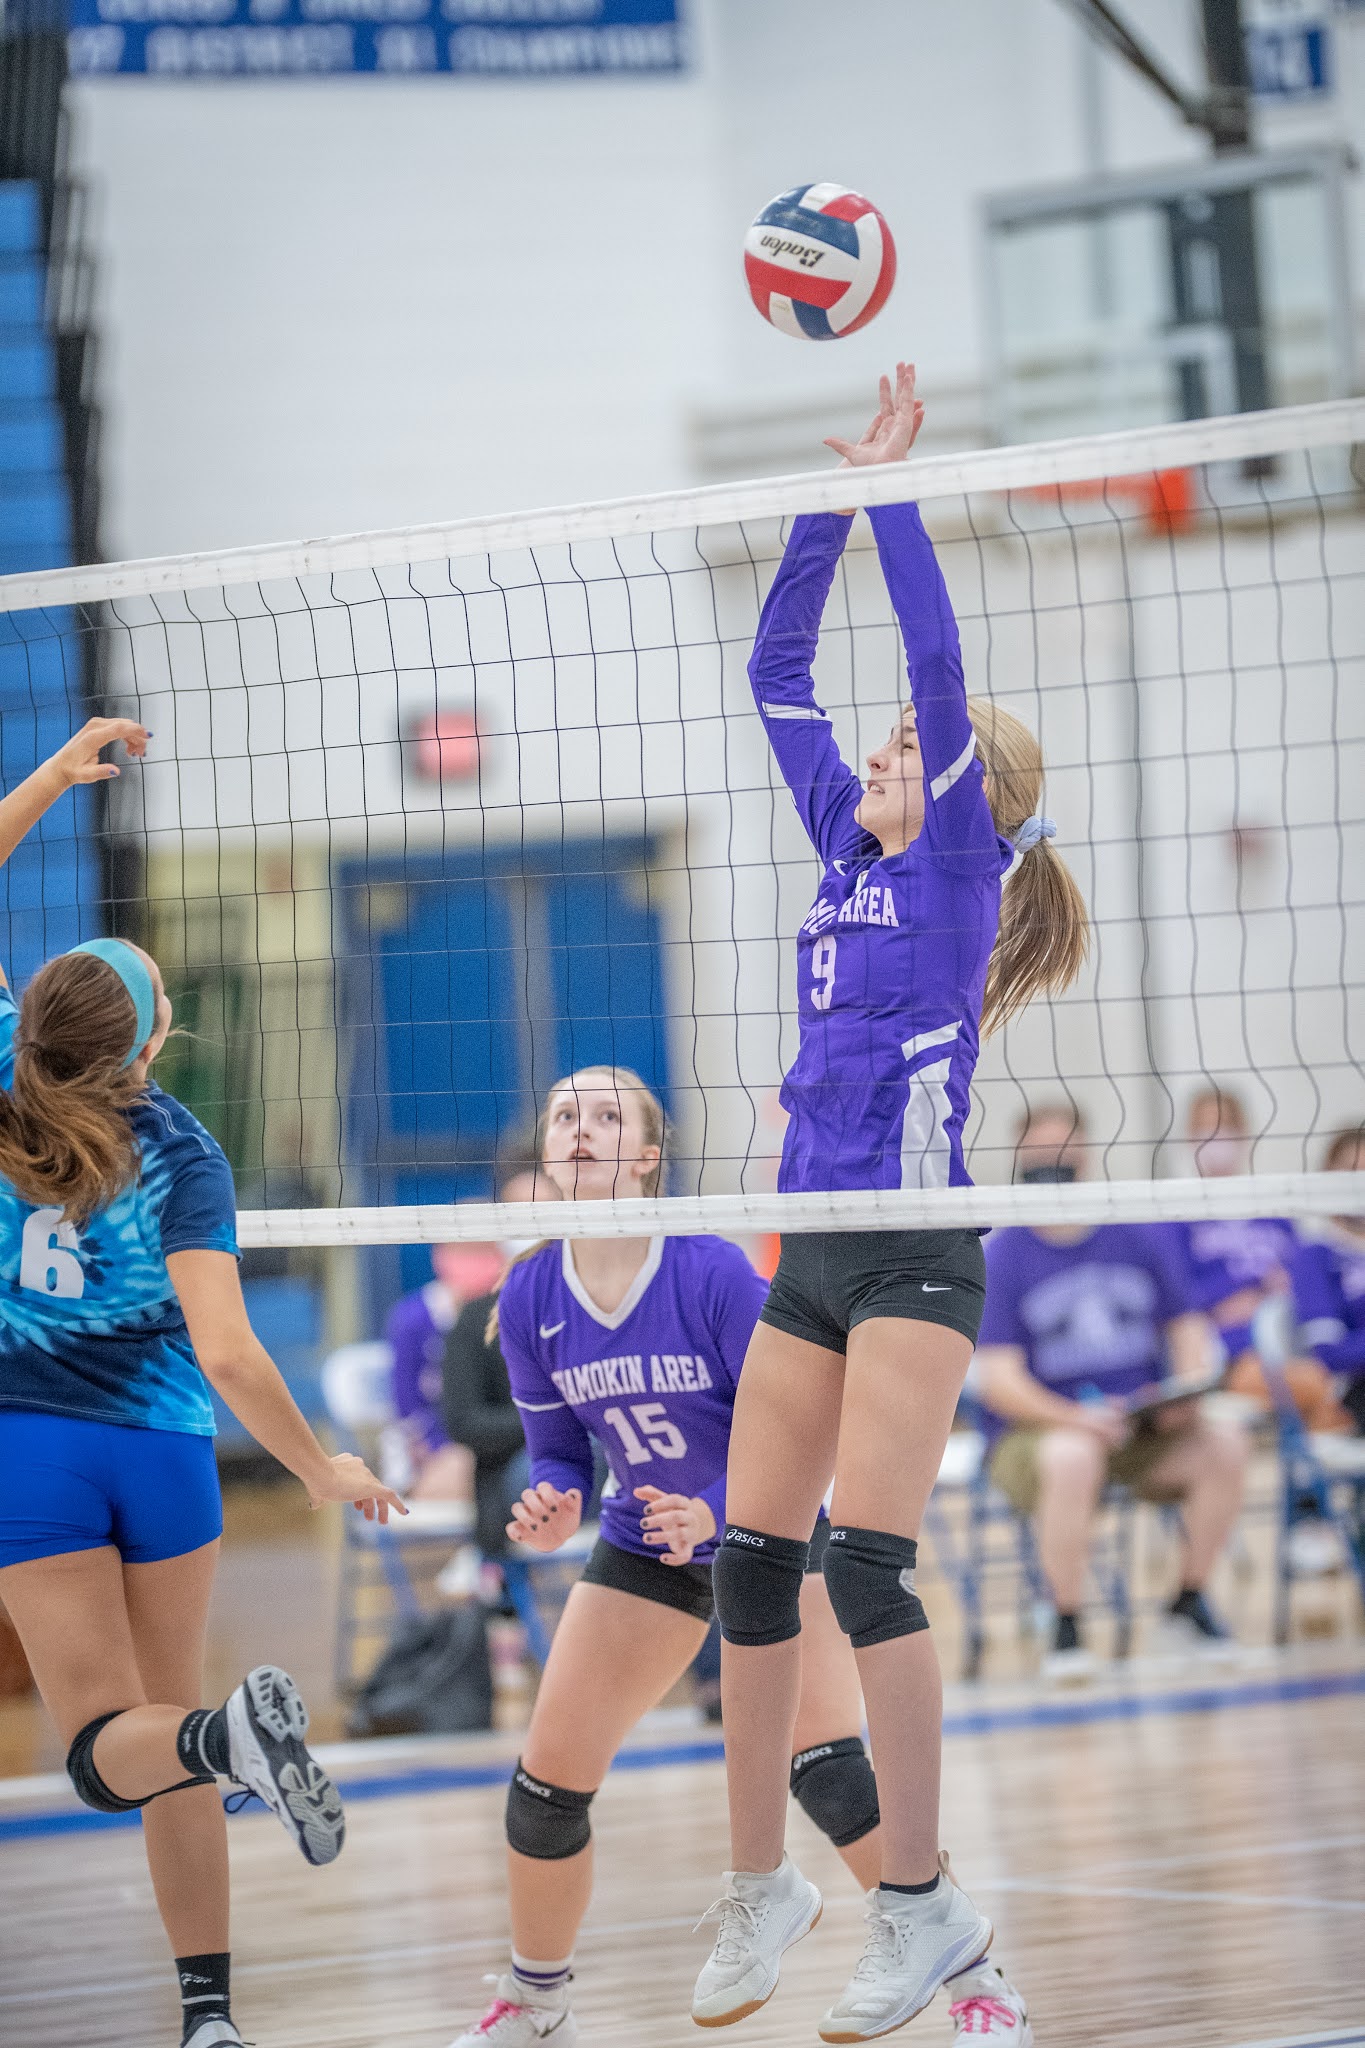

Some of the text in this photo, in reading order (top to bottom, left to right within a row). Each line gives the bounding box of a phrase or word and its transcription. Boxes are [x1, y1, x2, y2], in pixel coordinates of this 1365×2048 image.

[760, 234, 825, 268] Baden
[837, 886, 900, 928] AREA
[810, 934, 838, 1011] 9
[20, 1208, 85, 1299] 6
[650, 1354, 714, 1393] AREA
[603, 1402, 689, 1466] 15
